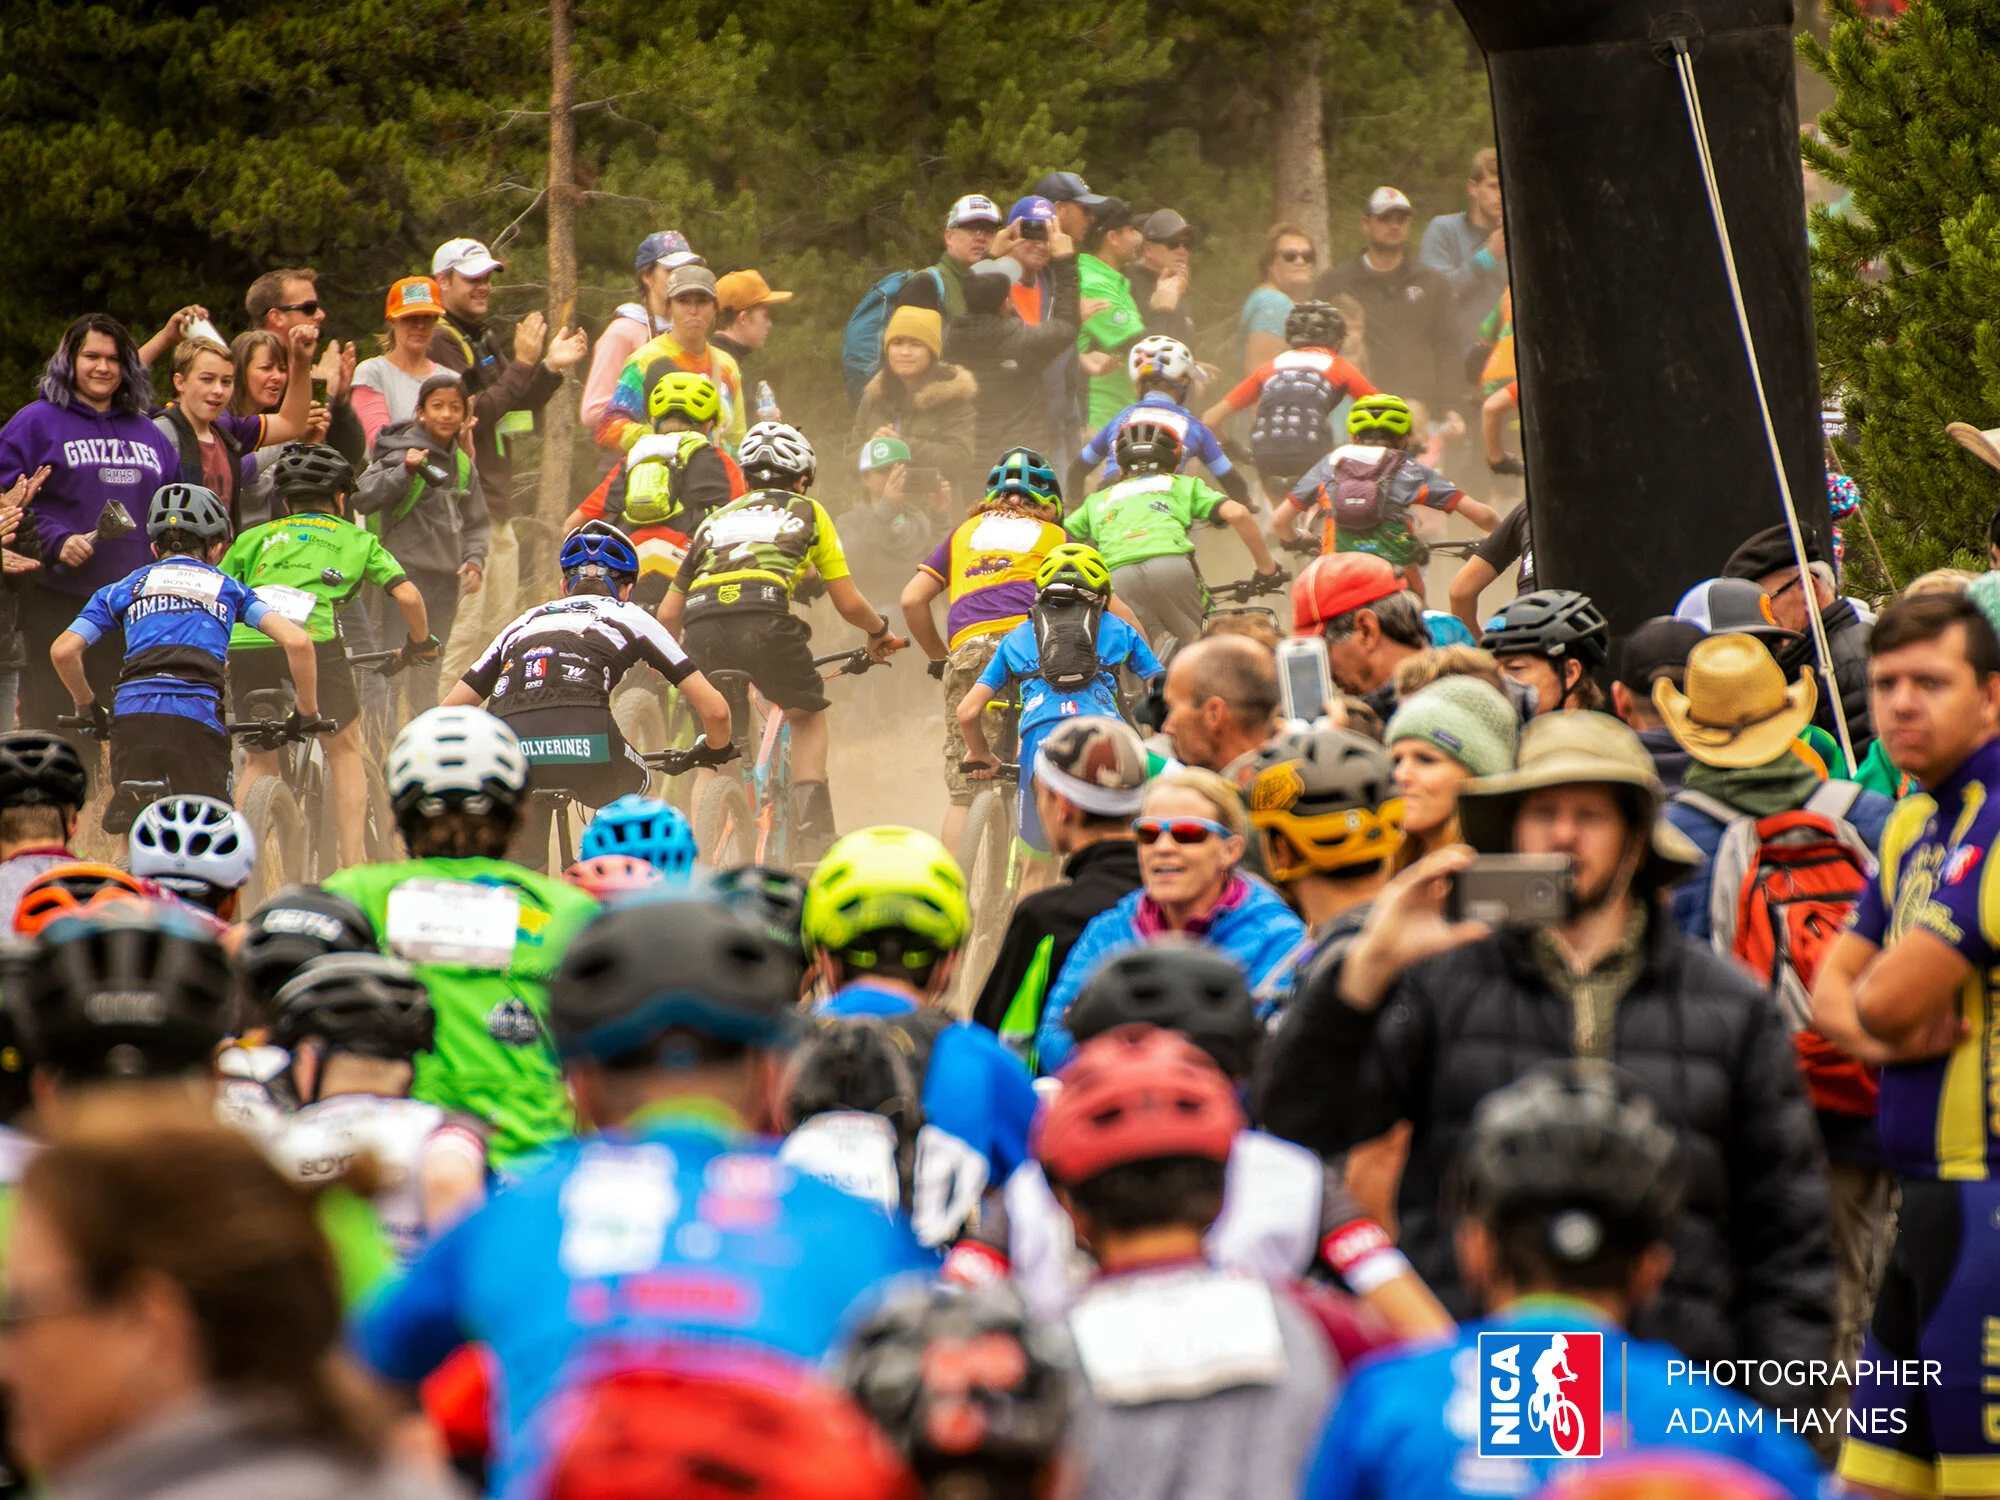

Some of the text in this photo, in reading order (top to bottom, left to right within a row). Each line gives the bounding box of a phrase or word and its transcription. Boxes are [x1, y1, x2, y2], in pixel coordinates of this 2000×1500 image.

[63, 439, 162, 475] GRIZZLIES
[105, 468, 135, 483] RMHS
[127, 594, 228, 625] TIMBERNE
[518, 738, 591, 758] OLVERINES
